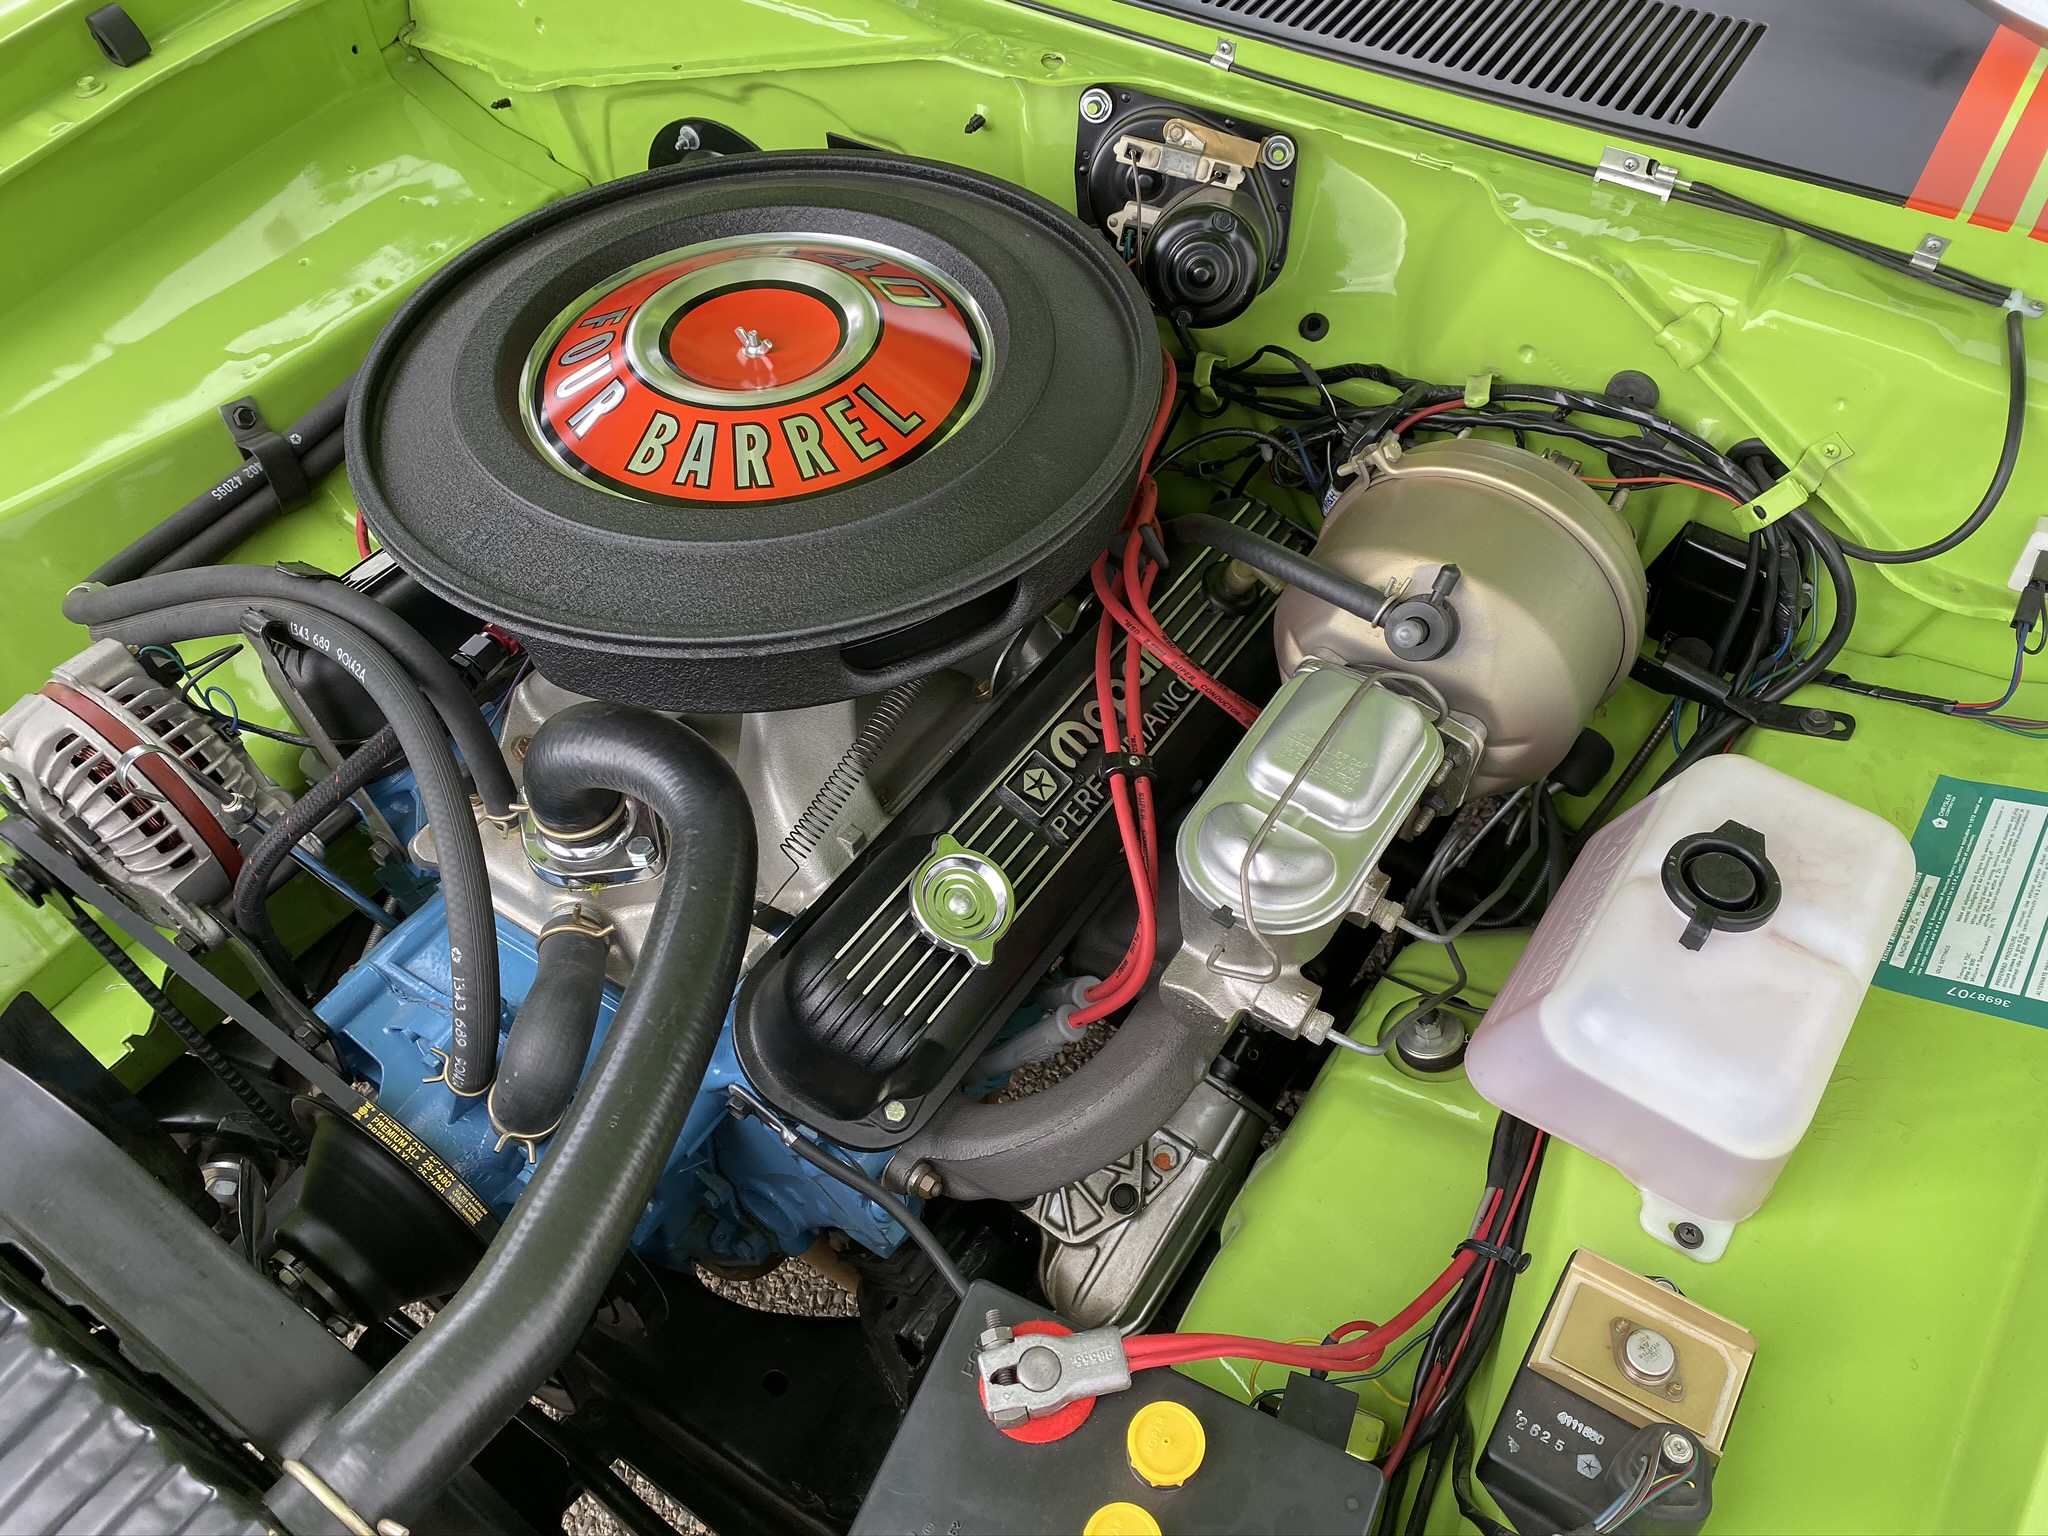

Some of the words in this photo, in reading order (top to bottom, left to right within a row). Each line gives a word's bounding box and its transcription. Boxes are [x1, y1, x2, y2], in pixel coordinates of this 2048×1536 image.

[556, 305, 637, 440] FOUR
[625, 383, 925, 490] BARREL
[211, 475, 243, 501] 42095
[290, 621, 309, 641] 1343
[312, 634, 330, 652] 689
[1170, 658, 1196, 681] SUPER
[1200, 682, 1240, 716] CONDUCTOR
[1137, 791, 1147, 820] SUPER
[1938, 793, 1953, 819] CHRYSLER
[1130, 932, 1141, 955] PLUG
[1898, 939, 1909, 957] ENGINE
[1907, 924, 1915, 934] 340
[1994, 961, 2007, 986] PREFERRED
[2004, 935, 2017, 960] PROCEDURE
[1947, 986, 2011, 1009] 3698707
[2035, 971, 2047, 996] ALTERNATE
[454, 1018, 467, 1047] 689
[370, 1115, 407, 1148] PREMIUM
[421, 1158, 452, 1188] 25-7490
[1145, 1416, 1168, 1457] MOPAR
